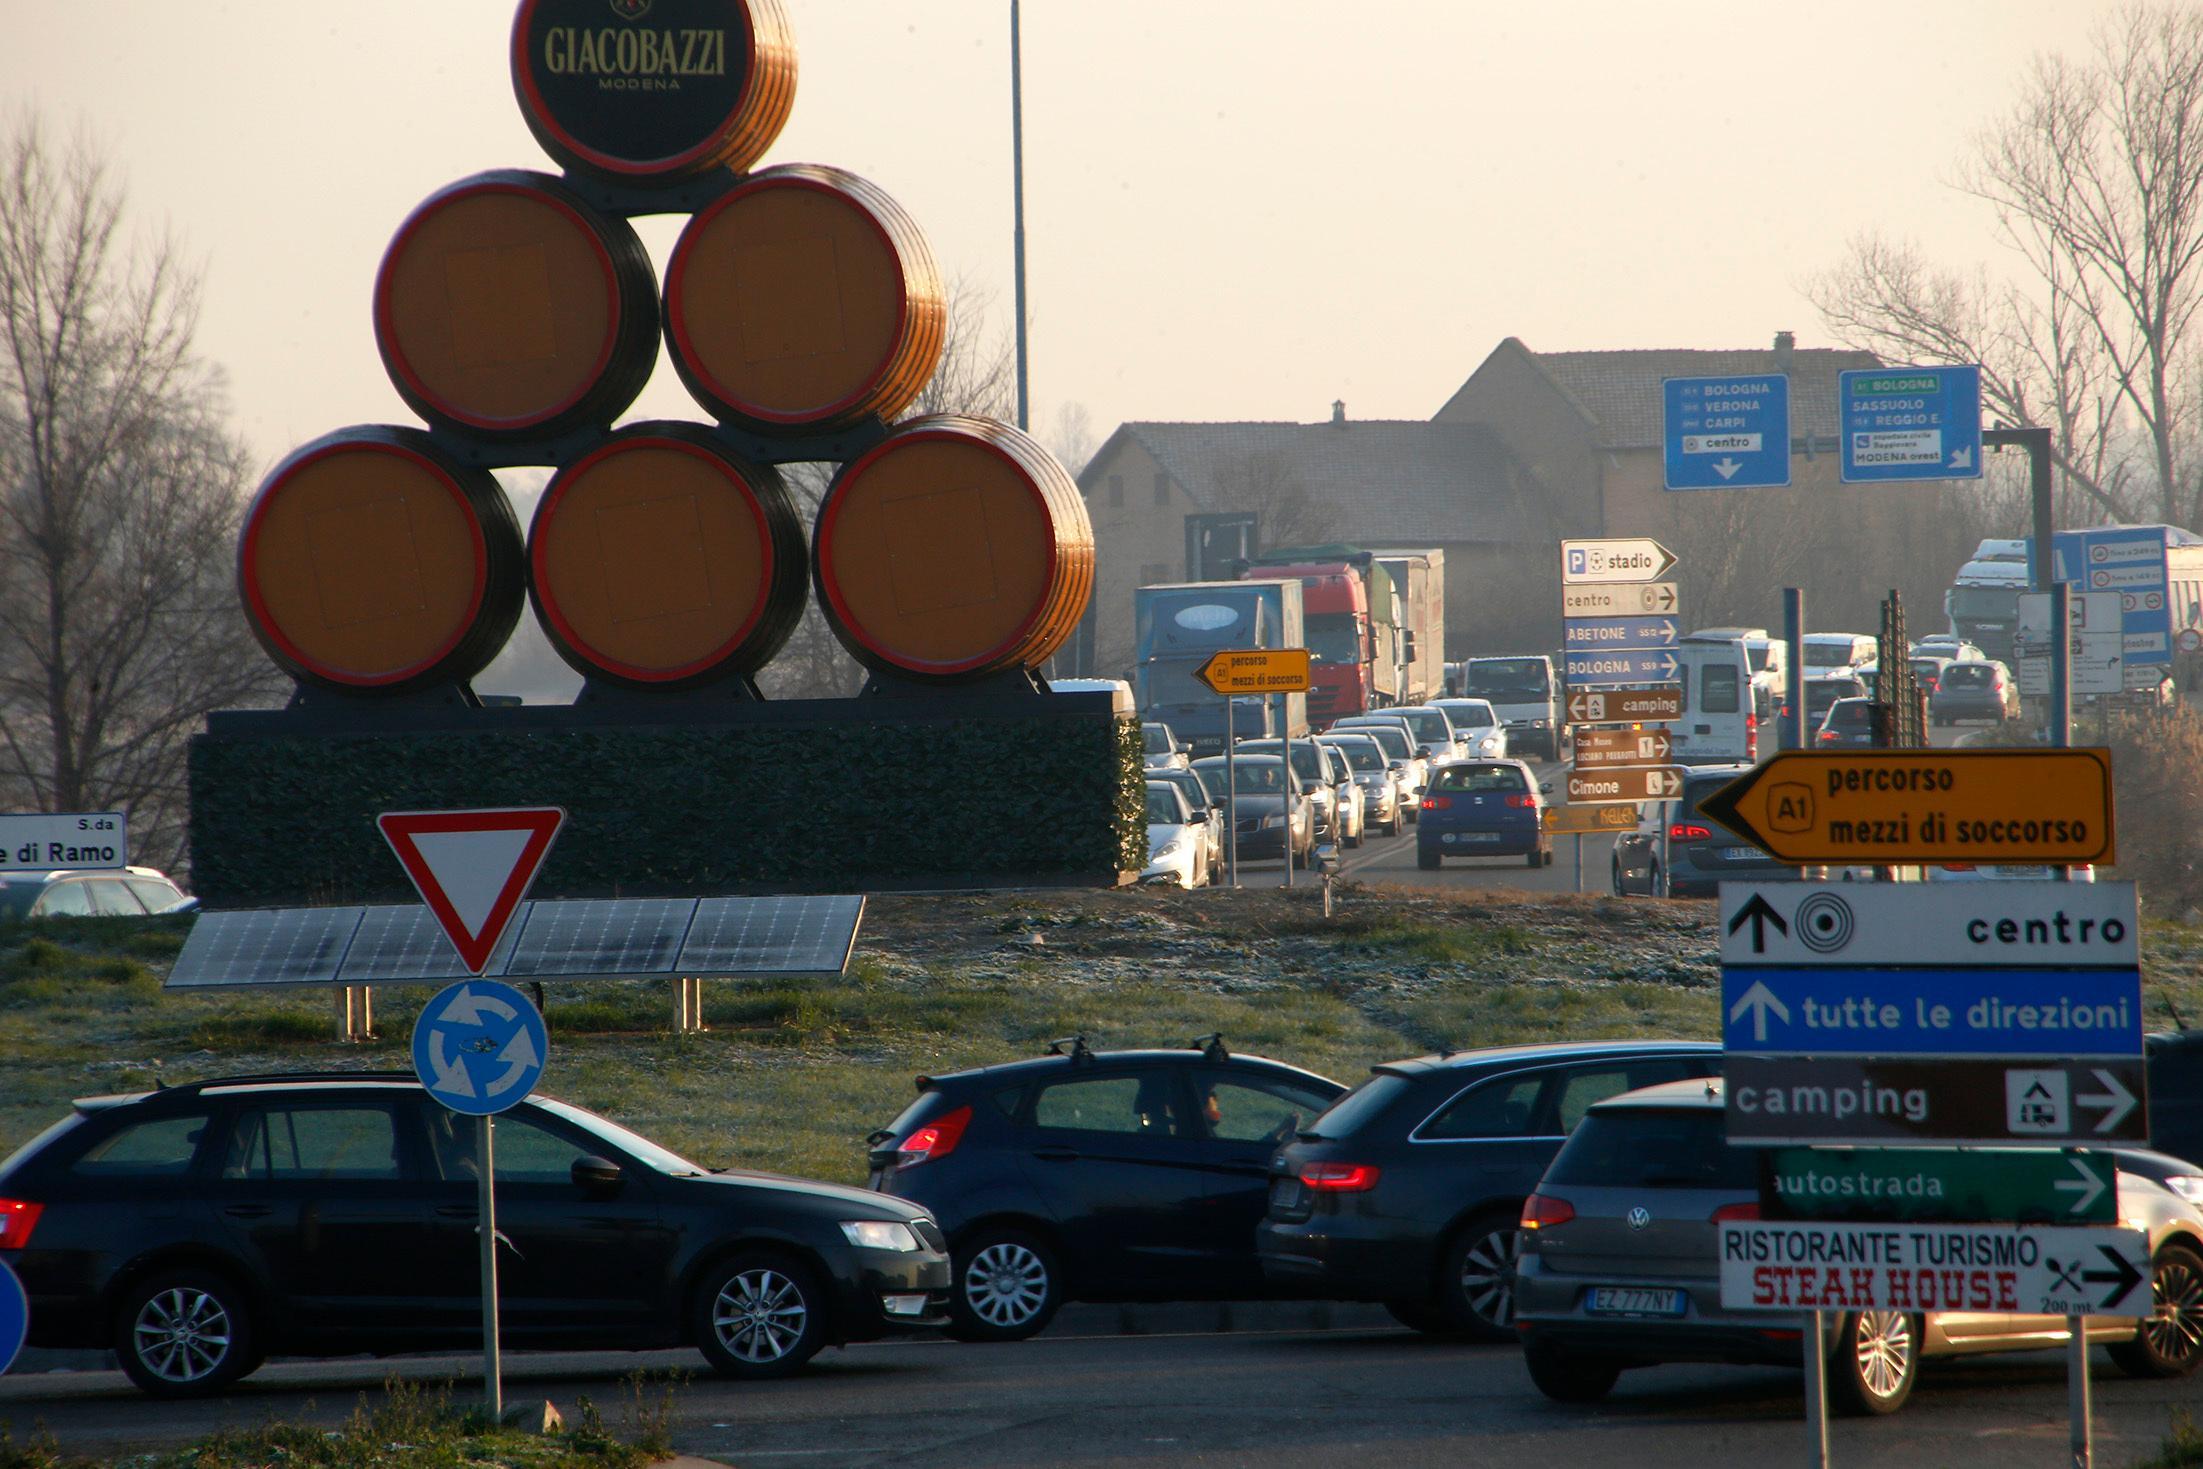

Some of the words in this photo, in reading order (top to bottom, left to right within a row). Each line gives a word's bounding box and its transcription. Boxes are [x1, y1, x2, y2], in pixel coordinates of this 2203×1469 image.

[545, 27, 726, 75] GIACOBAZZI
[599, 78, 680, 90] MODENA
[1704, 383, 1769, 396] BOLOGNA
[1872, 379, 1935, 391] BOLOGNA
[1705, 400, 1760, 411] VERONA
[1852, 399, 1924, 412] SASSUOLO
[1705, 417, 1745, 428] CARPI
[1876, 414, 1927, 426] REGGIO
[1706, 436, 1749, 448] centro
[1856, 453, 1907, 462] MODENA
[1910, 451, 1939, 460] ovest
[1608, 553, 1651, 568] stadio
[1567, 594, 1611, 607] centro
[1568, 627, 1626, 640] ABETONE
[1231, 656, 1267, 669] percorso
[1568, 661, 1631, 674] BOLOGNA
[1231, 673, 1255, 686] mezzi
[1257, 673, 1265, 685] di
[1267, 675, 1304, 685] soccorso
[1622, 697, 1677, 713] camping
[1569, 778, 1620, 796] Cimone
[1827, 765, 1954, 797] percorso
[1777, 797, 1805, 819] A1
[78, 819, 114, 831] S.da
[1828, 813, 1909, 843] mezzi
[1919, 813, 1946, 843] di
[1956, 816, 2087, 843] soccorso
[17, 843, 38, 862] di
[49, 843, 115, 862] Ramo
[1966, 911, 2126, 944] centro
[1802, 997, 1901, 1028] tutte
[1916, 997, 1951, 1028] le
[1967, 997, 2128, 1028] direzioni
[1736, 1079, 1928, 1121] camping
[1724, 1230, 1900, 1263] RISTORANTE
[1909, 1233, 2038, 1266] TURISMO
[1752, 1267, 1875, 1308] STEAK
[1886, 1270, 2018, 1310] HOUSE
[2041, 1297, 2068, 1314] 200
